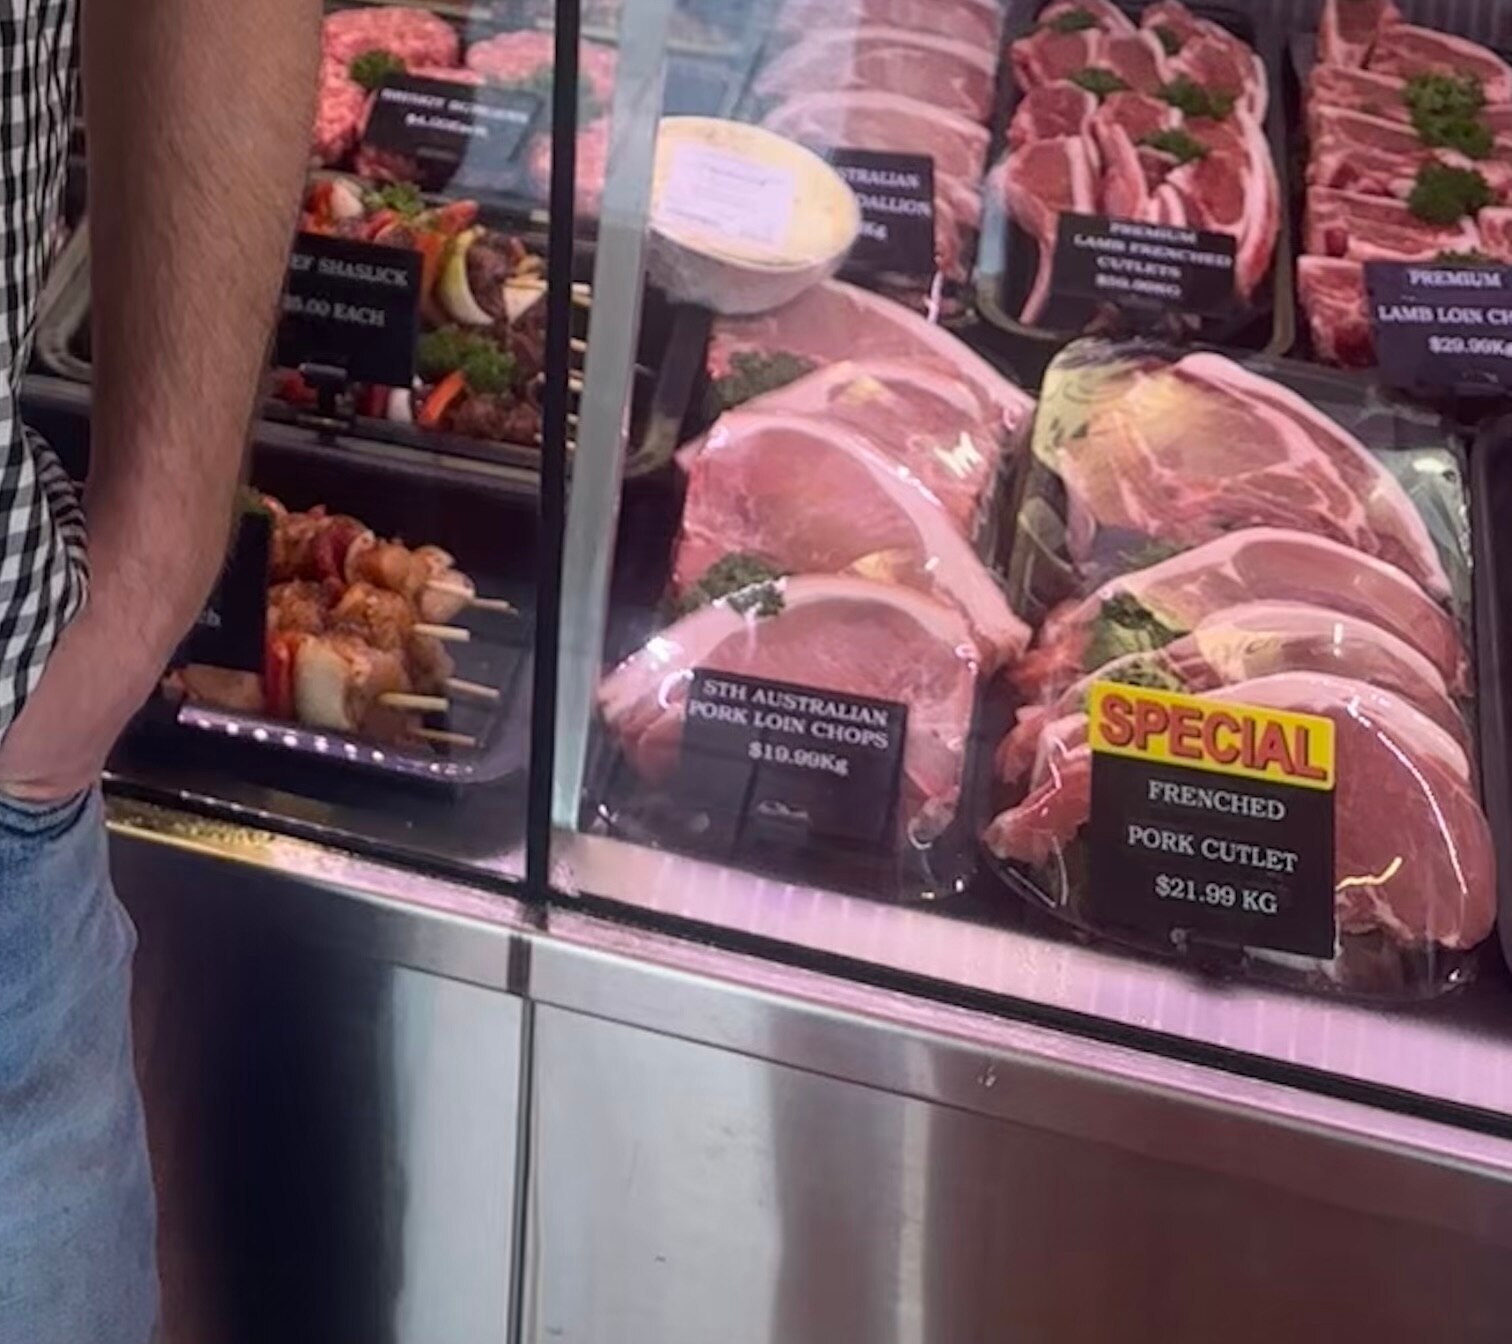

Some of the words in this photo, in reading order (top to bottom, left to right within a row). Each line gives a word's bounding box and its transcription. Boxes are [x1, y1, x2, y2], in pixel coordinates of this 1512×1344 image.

[1073, 232, 1127, 252] LAMB
[1408, 269, 1502, 288] PREMIUM
[332, 301, 386, 328] EACH
[1377, 304, 1434, 323] LAMB
[1435, 306, 1484, 325] LOIN
[702, 678, 748, 701] STH
[751, 687, 888, 727] AUSTRALIAN
[688, 699, 749, 726] PORK
[752, 709, 806, 735] LOIN
[810, 720, 889, 749] CHOPS
[1098, 692, 1328, 782] SPECIAL
[1147, 778, 1287, 821] FRENCHED
[1126, 824, 1195, 856] PORK
[1200, 837, 1299, 873] CUTLET
[1154, 873, 1236, 908] $21.99
[1241, 888, 1279, 914] KG
